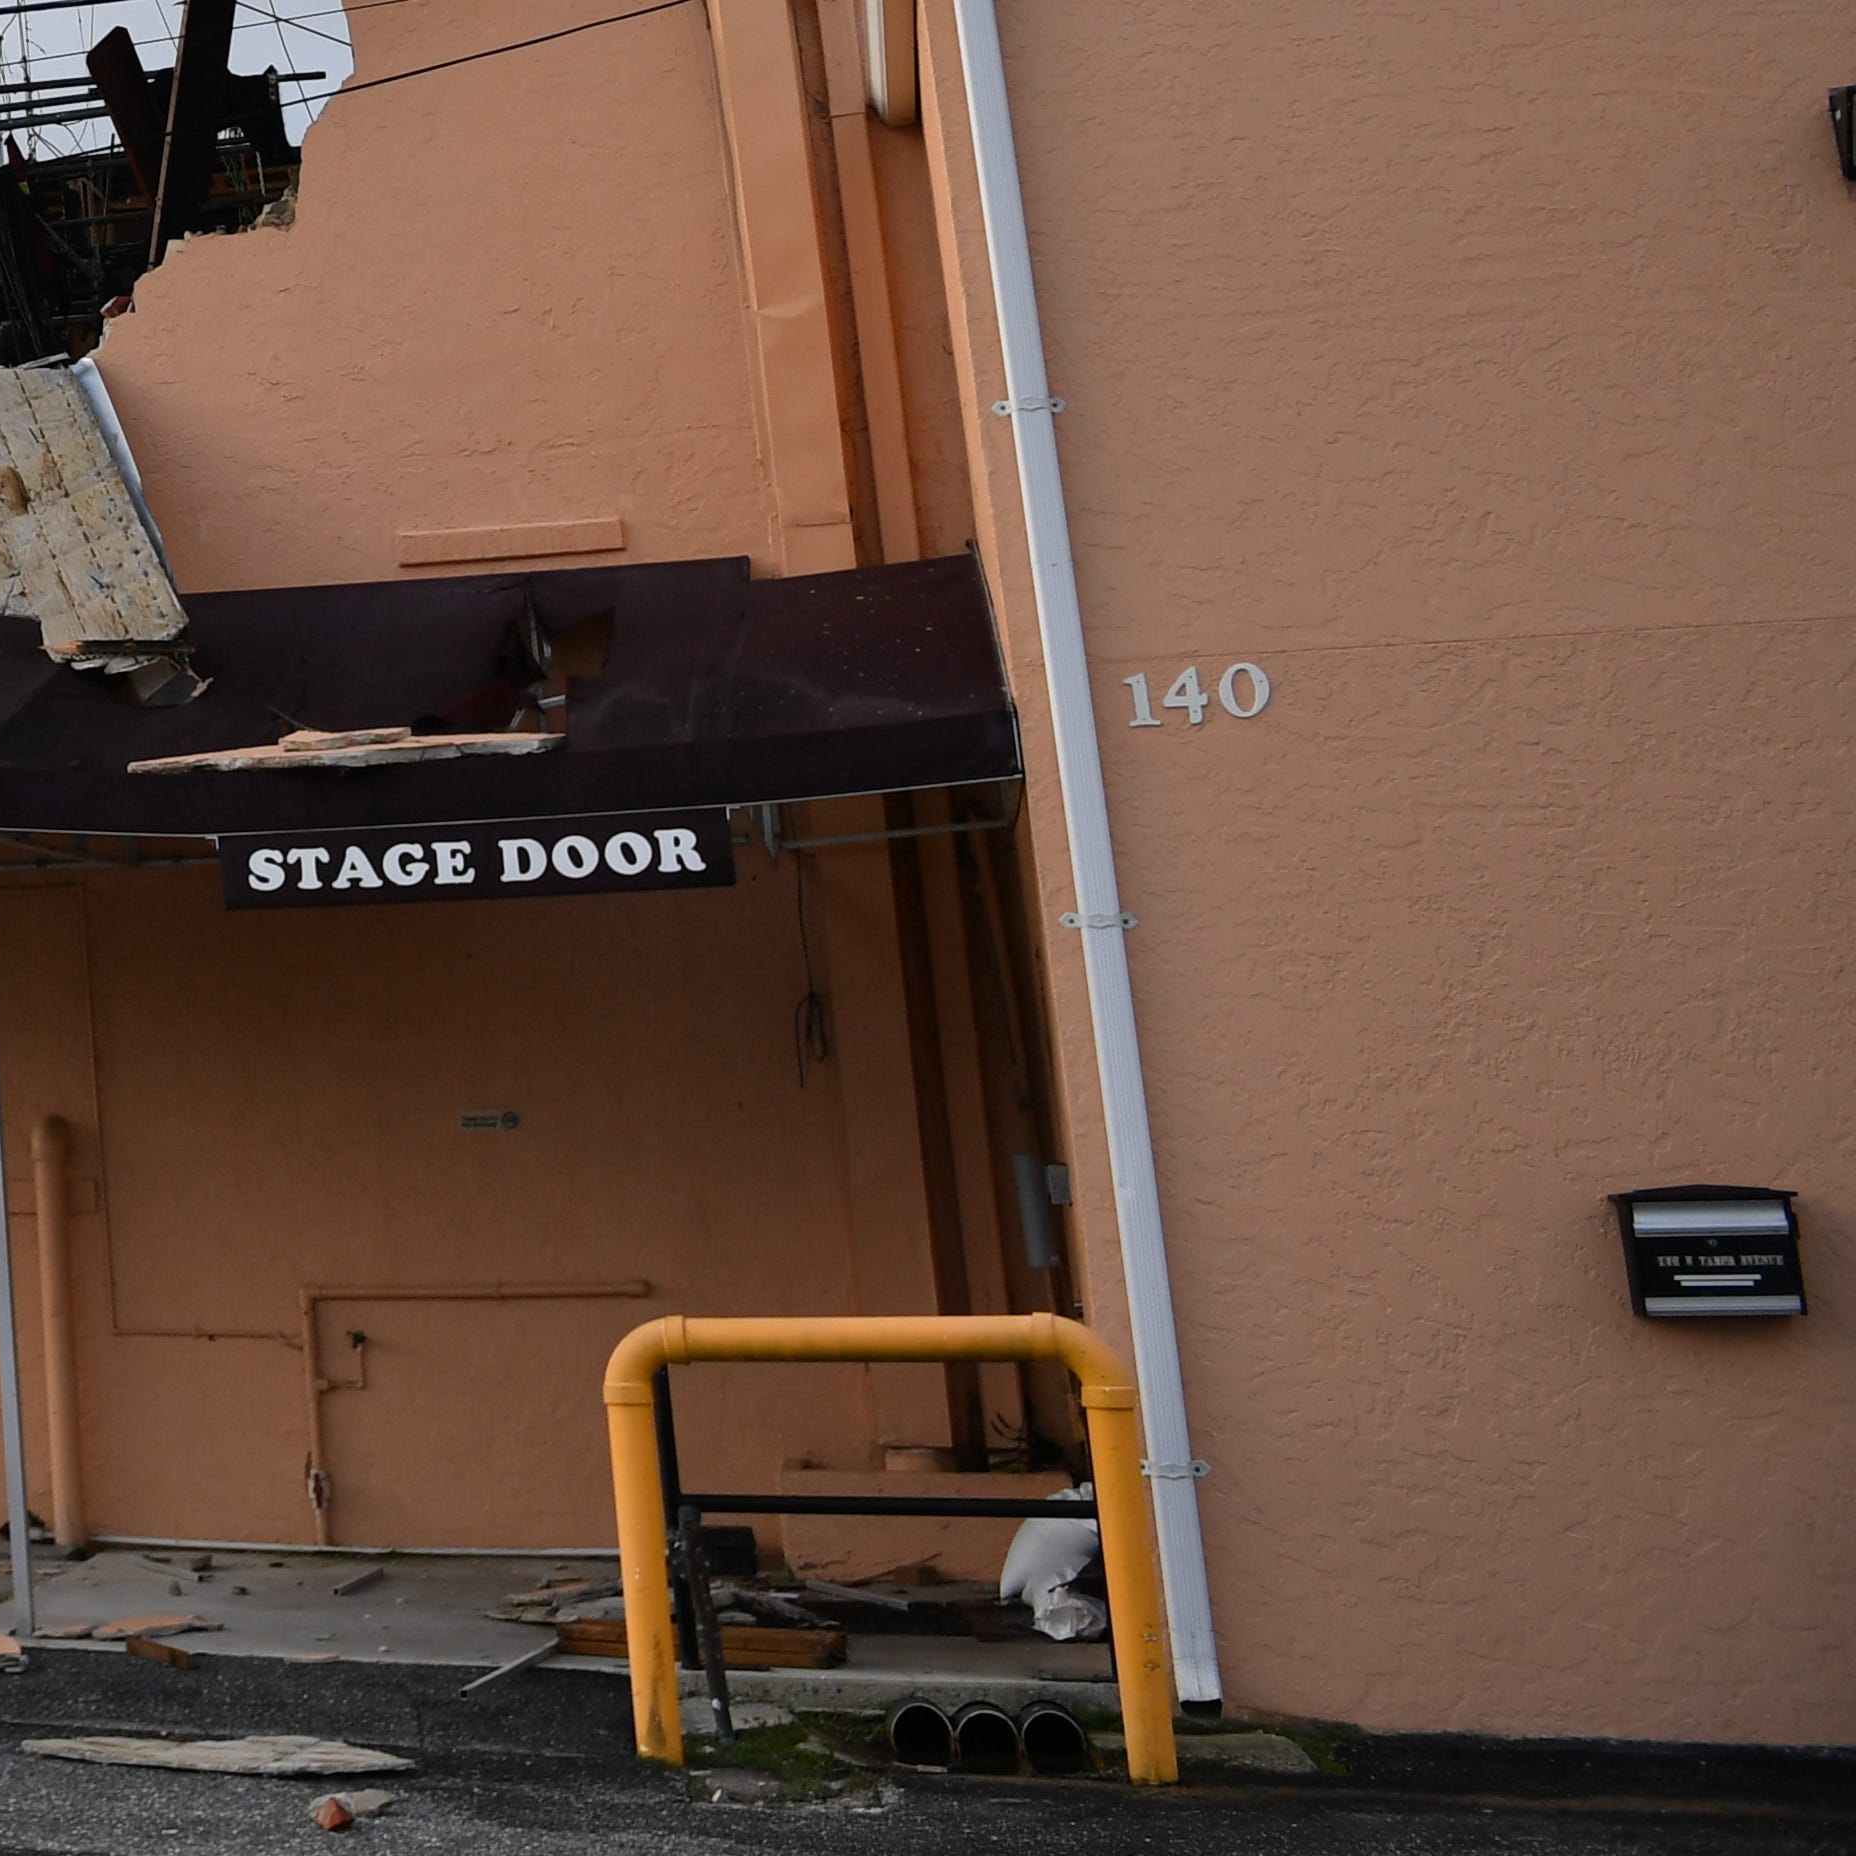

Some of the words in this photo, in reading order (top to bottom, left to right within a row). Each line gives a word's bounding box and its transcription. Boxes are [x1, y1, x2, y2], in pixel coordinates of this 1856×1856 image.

[1123, 662, 1270, 727] 140
[248, 841, 475, 891] STAGE
[497, 828, 706, 883] DOOR
